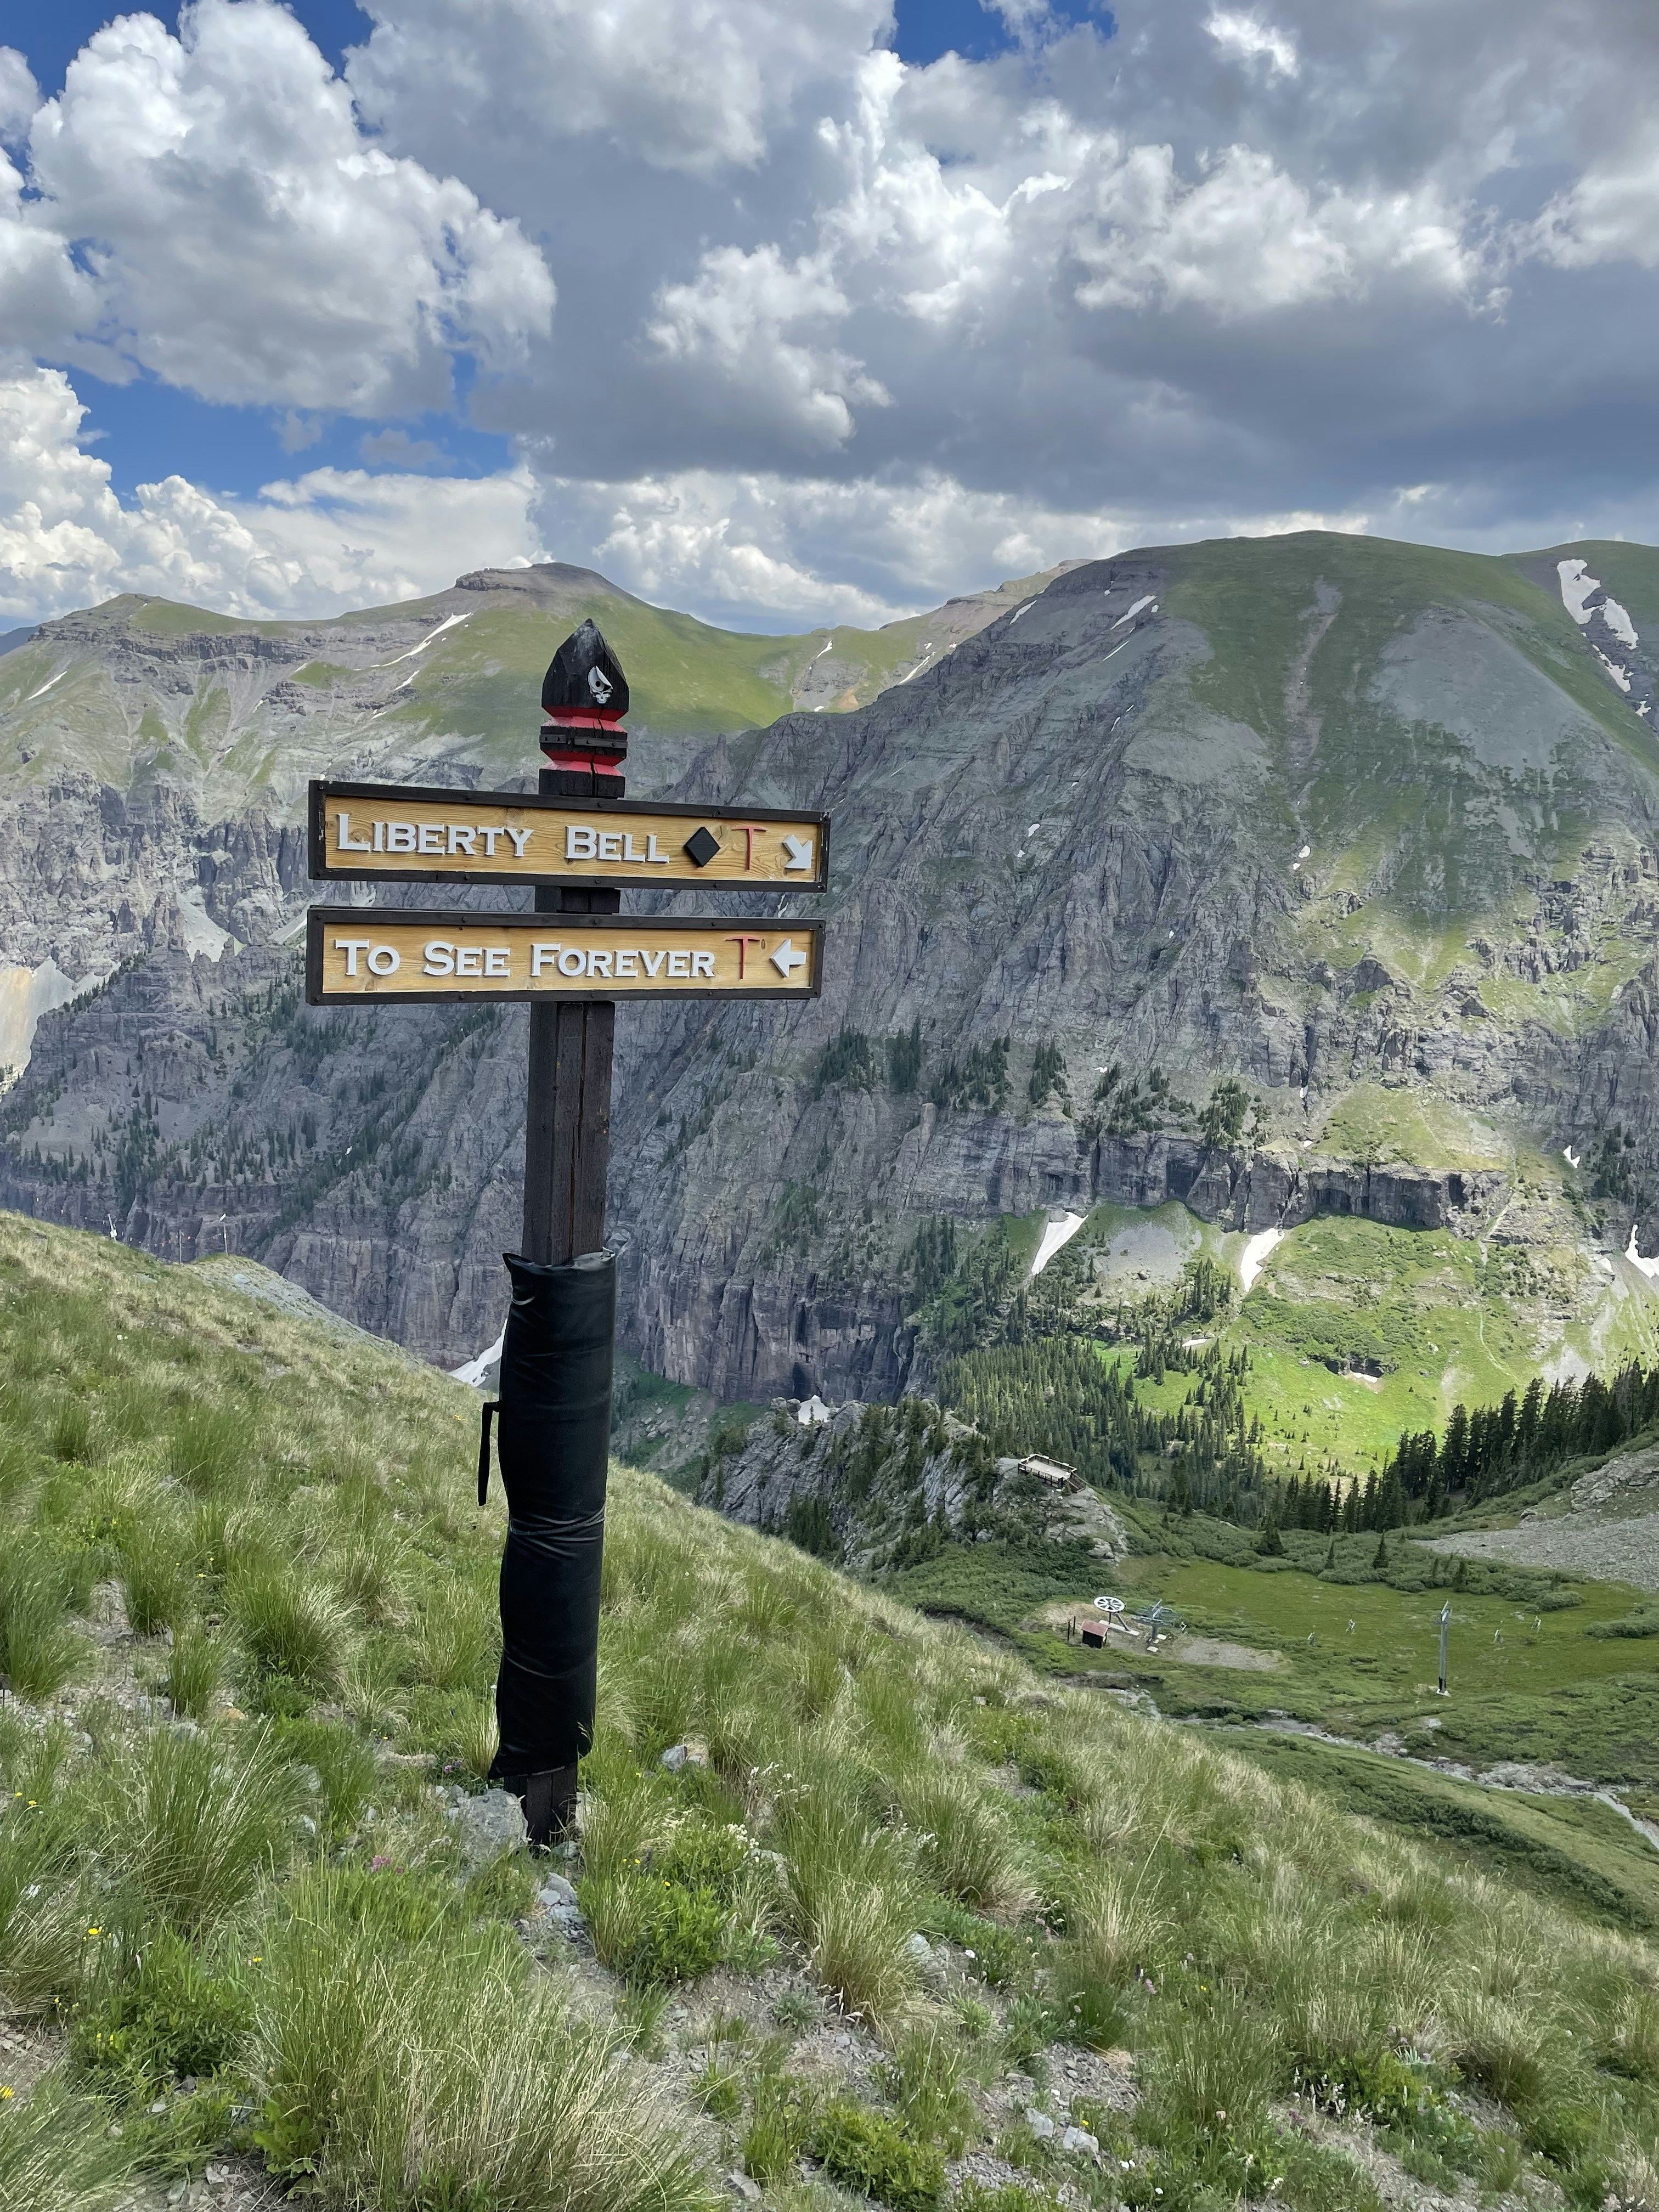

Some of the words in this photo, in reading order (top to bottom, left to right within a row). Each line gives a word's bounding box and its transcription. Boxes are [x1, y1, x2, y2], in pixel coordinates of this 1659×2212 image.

[337, 813, 534, 857] LIBERTY
[565, 825, 670, 864] BELL
[334, 939, 400, 976] TO
[422, 940, 511, 977] SEE
[531, 942, 715, 978] FOREVER
